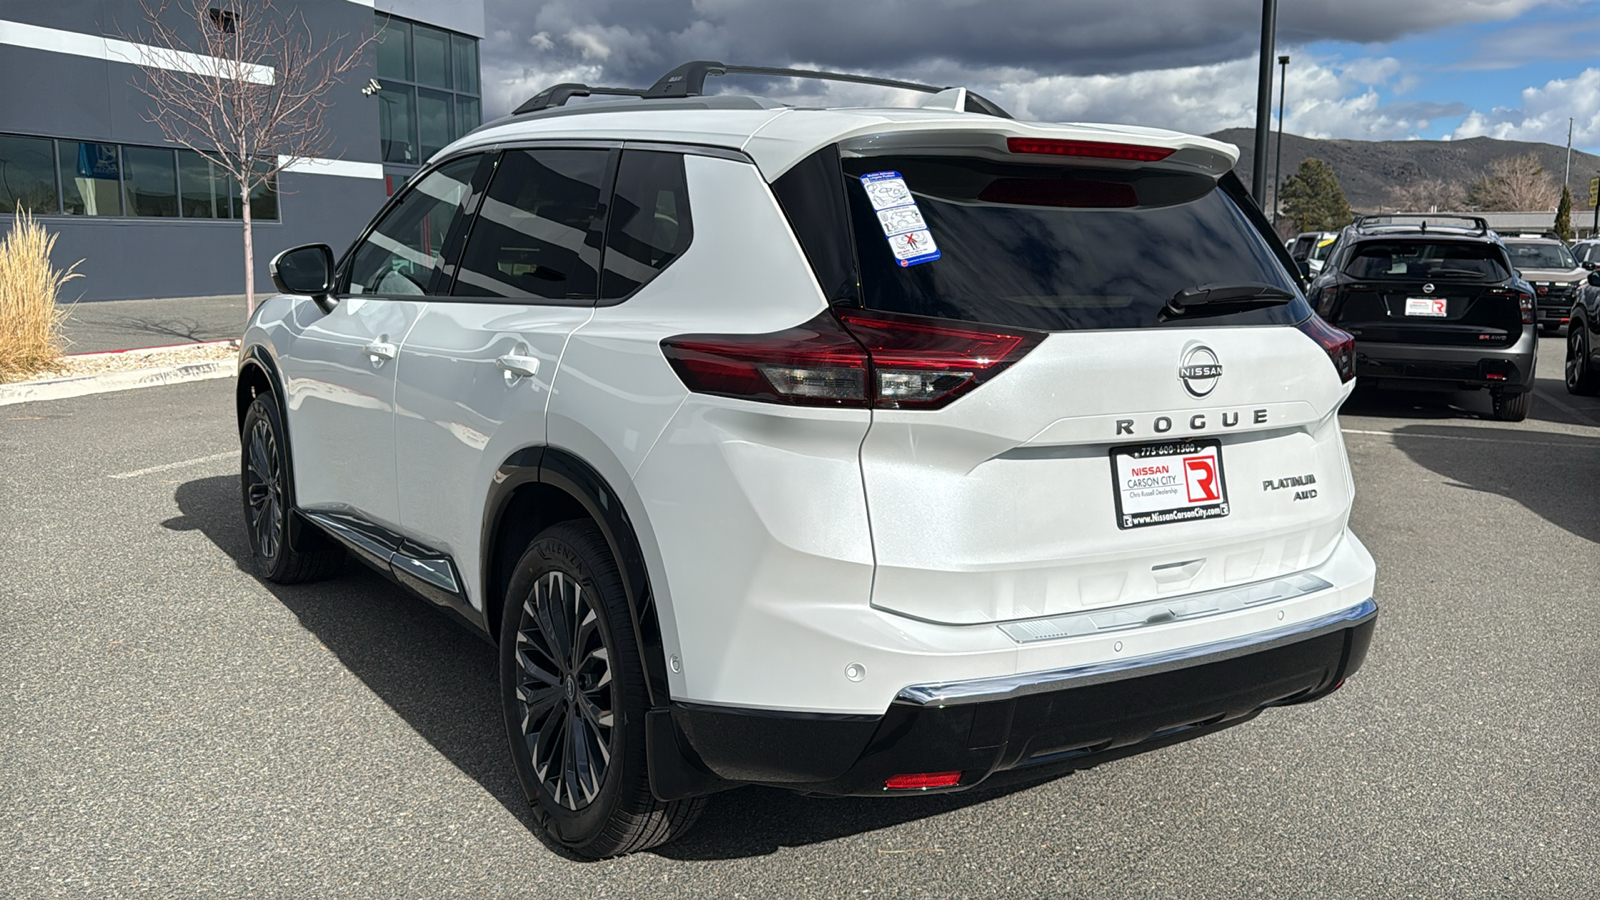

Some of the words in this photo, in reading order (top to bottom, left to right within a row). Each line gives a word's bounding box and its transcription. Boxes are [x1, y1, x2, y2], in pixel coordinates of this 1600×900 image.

[1181, 366, 1223, 378] NISSAN
[1116, 409, 1268, 435] ROGUE
[1141, 444, 1195, 456] 775-600-1500
[1131, 465, 1169, 477] NISSAN
[1127, 477, 1160, 488] CARSON
[1160, 475, 1177, 485] CITY
[1263, 474, 1316, 491] PLATINUM
[1141, 489, 1155, 497] Russell
[1155, 488, 1179, 496] Dealership
[1293, 489, 1318, 501] AWD
[1132, 507, 1221, 525] www.NissanCarsonCity.com
[545, 541, 583, 574] ALENZA
